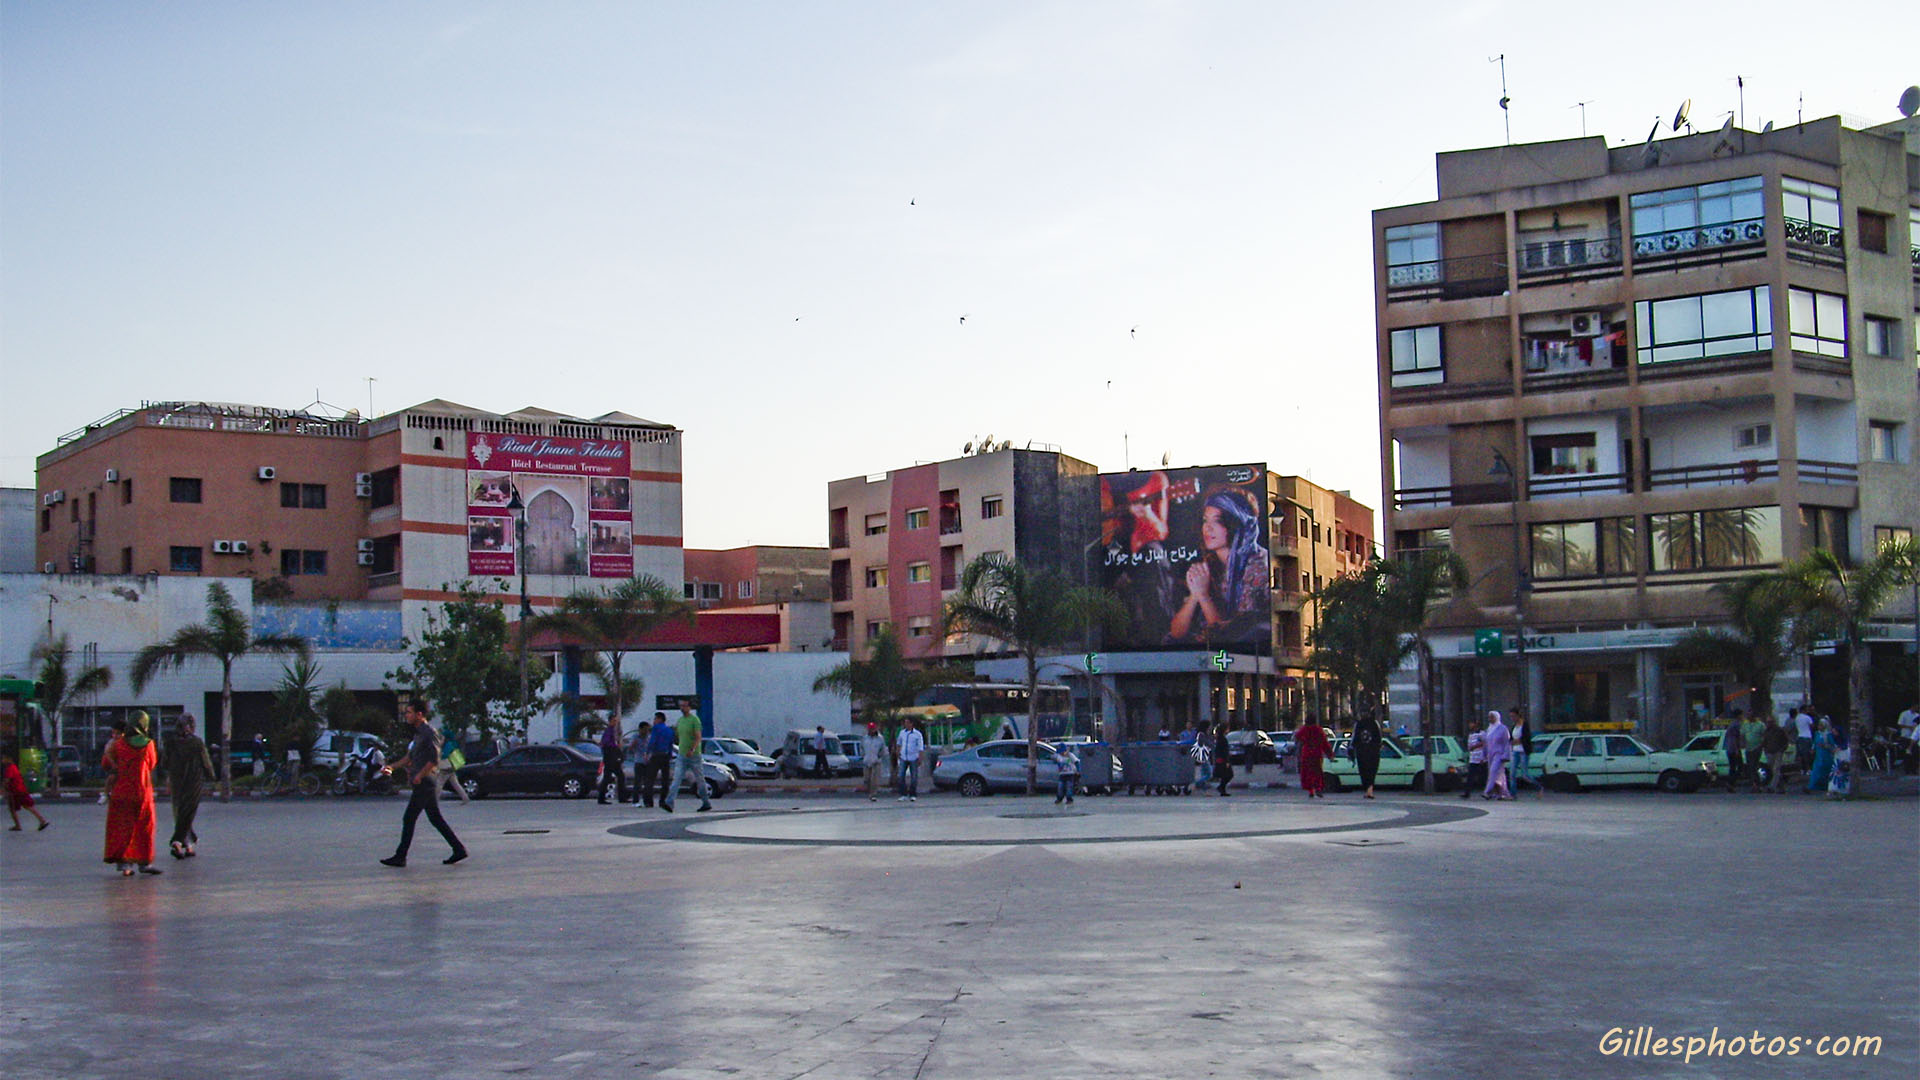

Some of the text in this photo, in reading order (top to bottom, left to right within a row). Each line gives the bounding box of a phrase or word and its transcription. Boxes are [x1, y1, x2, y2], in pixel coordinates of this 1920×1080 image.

[497, 437, 537, 454] Riad
[534, 439, 576, 457] Jnane
[511, 459, 612, 473] Hôtel Restaurant Terrasse
[1131, 552, 1143, 566] مع
[1145, 548, 1168, 564] البال
[1170, 546, 1198, 562] مرتاح
[1508, 636, 1555, 649] BMCI
